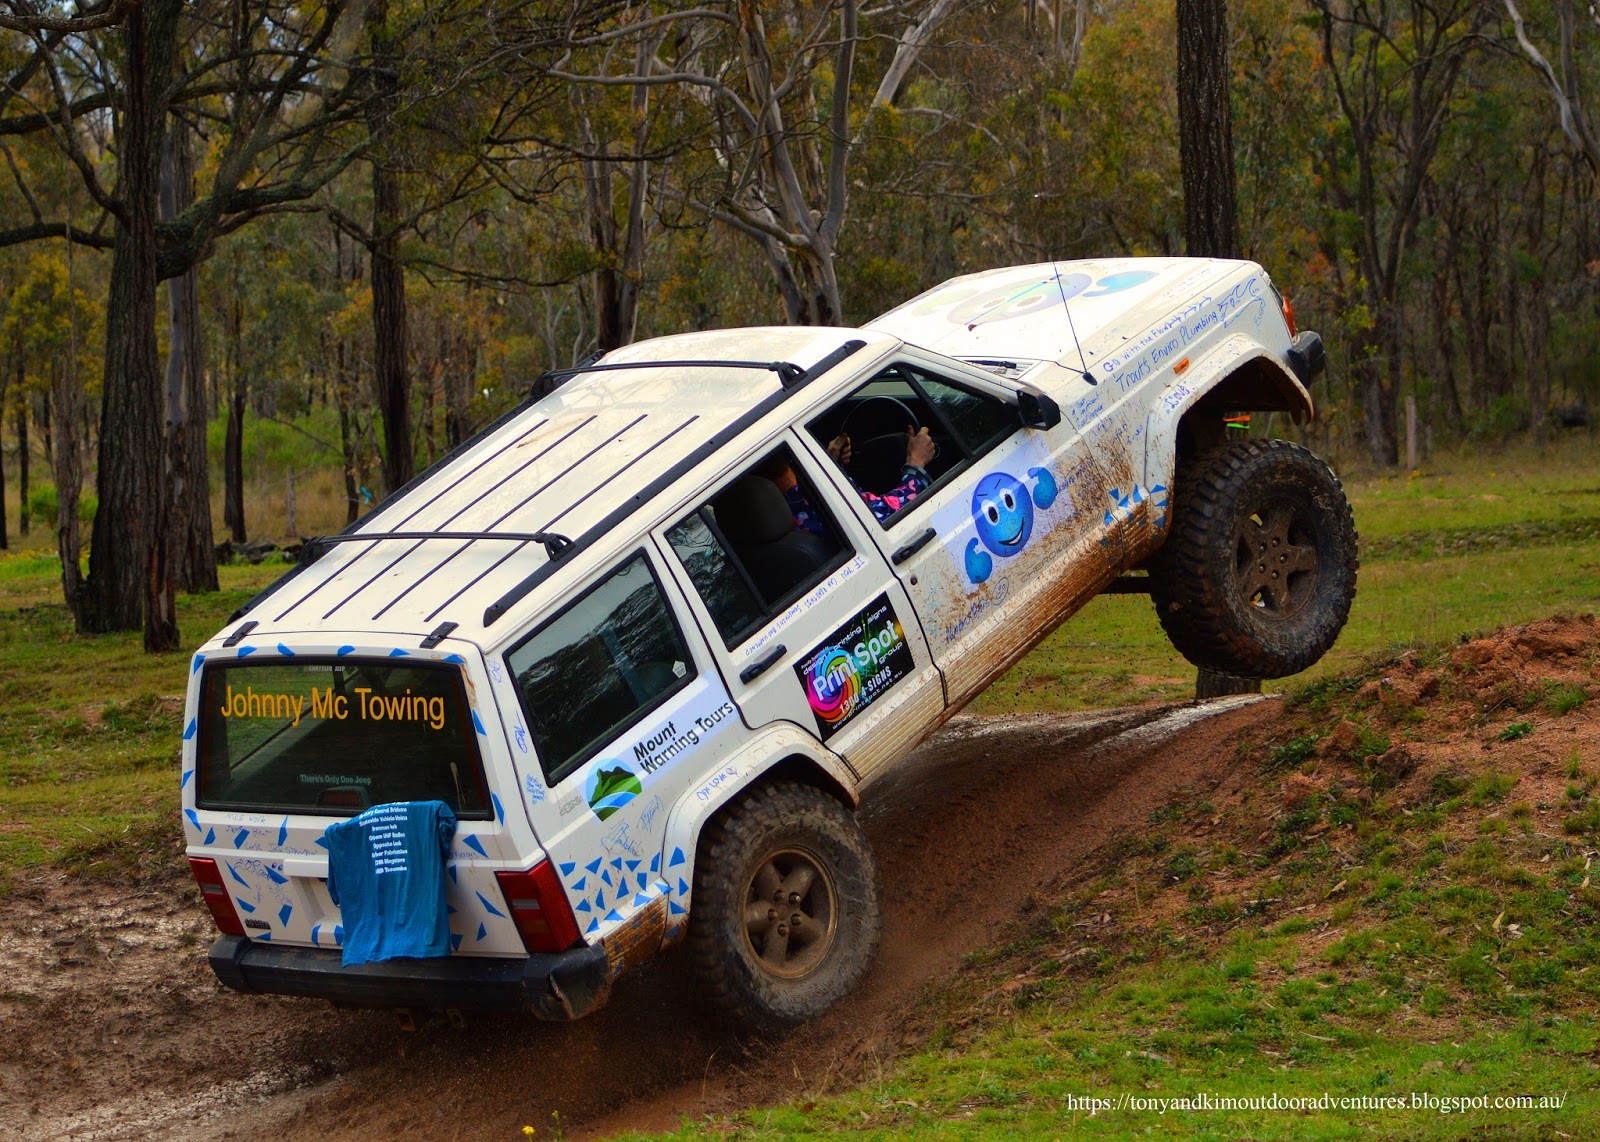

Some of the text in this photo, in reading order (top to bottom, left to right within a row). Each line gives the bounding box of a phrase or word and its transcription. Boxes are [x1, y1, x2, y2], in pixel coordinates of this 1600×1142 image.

[1103, 358, 1121, 372] Go
[803, 654, 828, 675] design
[834, 625, 862, 651] printing
[867, 606, 887, 625] signs
[878, 642, 903, 665] group
[221, 686, 445, 730] Johnny Mc Towing
[839, 694, 860, 714] 1300
[633, 702, 734, 775] Mount Warning Tours
[299, 773, 372, 786] There's Only One Jeep
